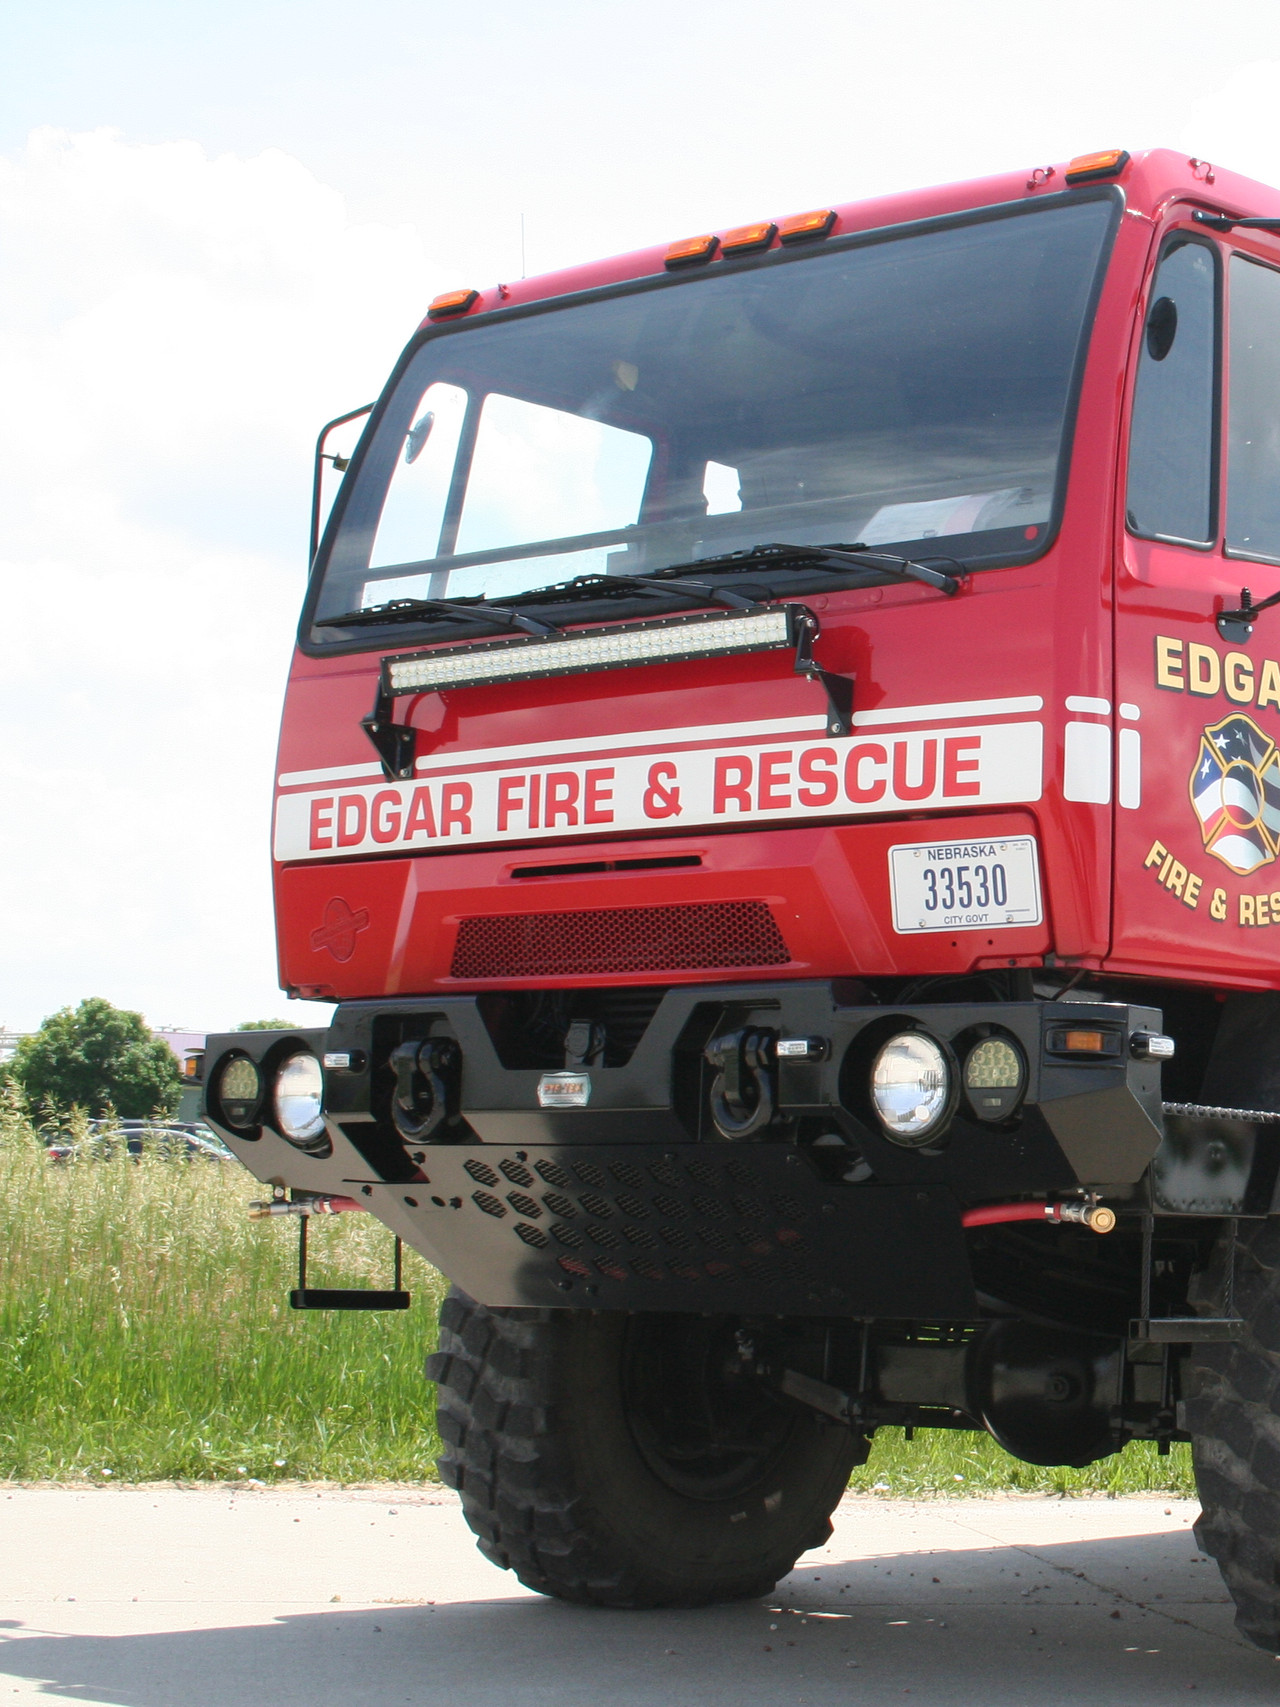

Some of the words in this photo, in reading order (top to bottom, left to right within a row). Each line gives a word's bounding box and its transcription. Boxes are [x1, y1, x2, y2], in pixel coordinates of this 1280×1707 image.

[309, 781, 473, 851] EDGAR
[497, 767, 615, 832] FIRE
[643, 761, 683, 820] &
[713, 736, 981, 814] RESCUE
[927, 845, 997, 861] NEBRASKA
[923, 864, 1008, 910] 33530
[1144, 840, 1203, 908] FIRE
[1210, 888, 1227, 921] &
[944, 915, 963, 925] CITY
[965, 914, 989, 923] GOVT
